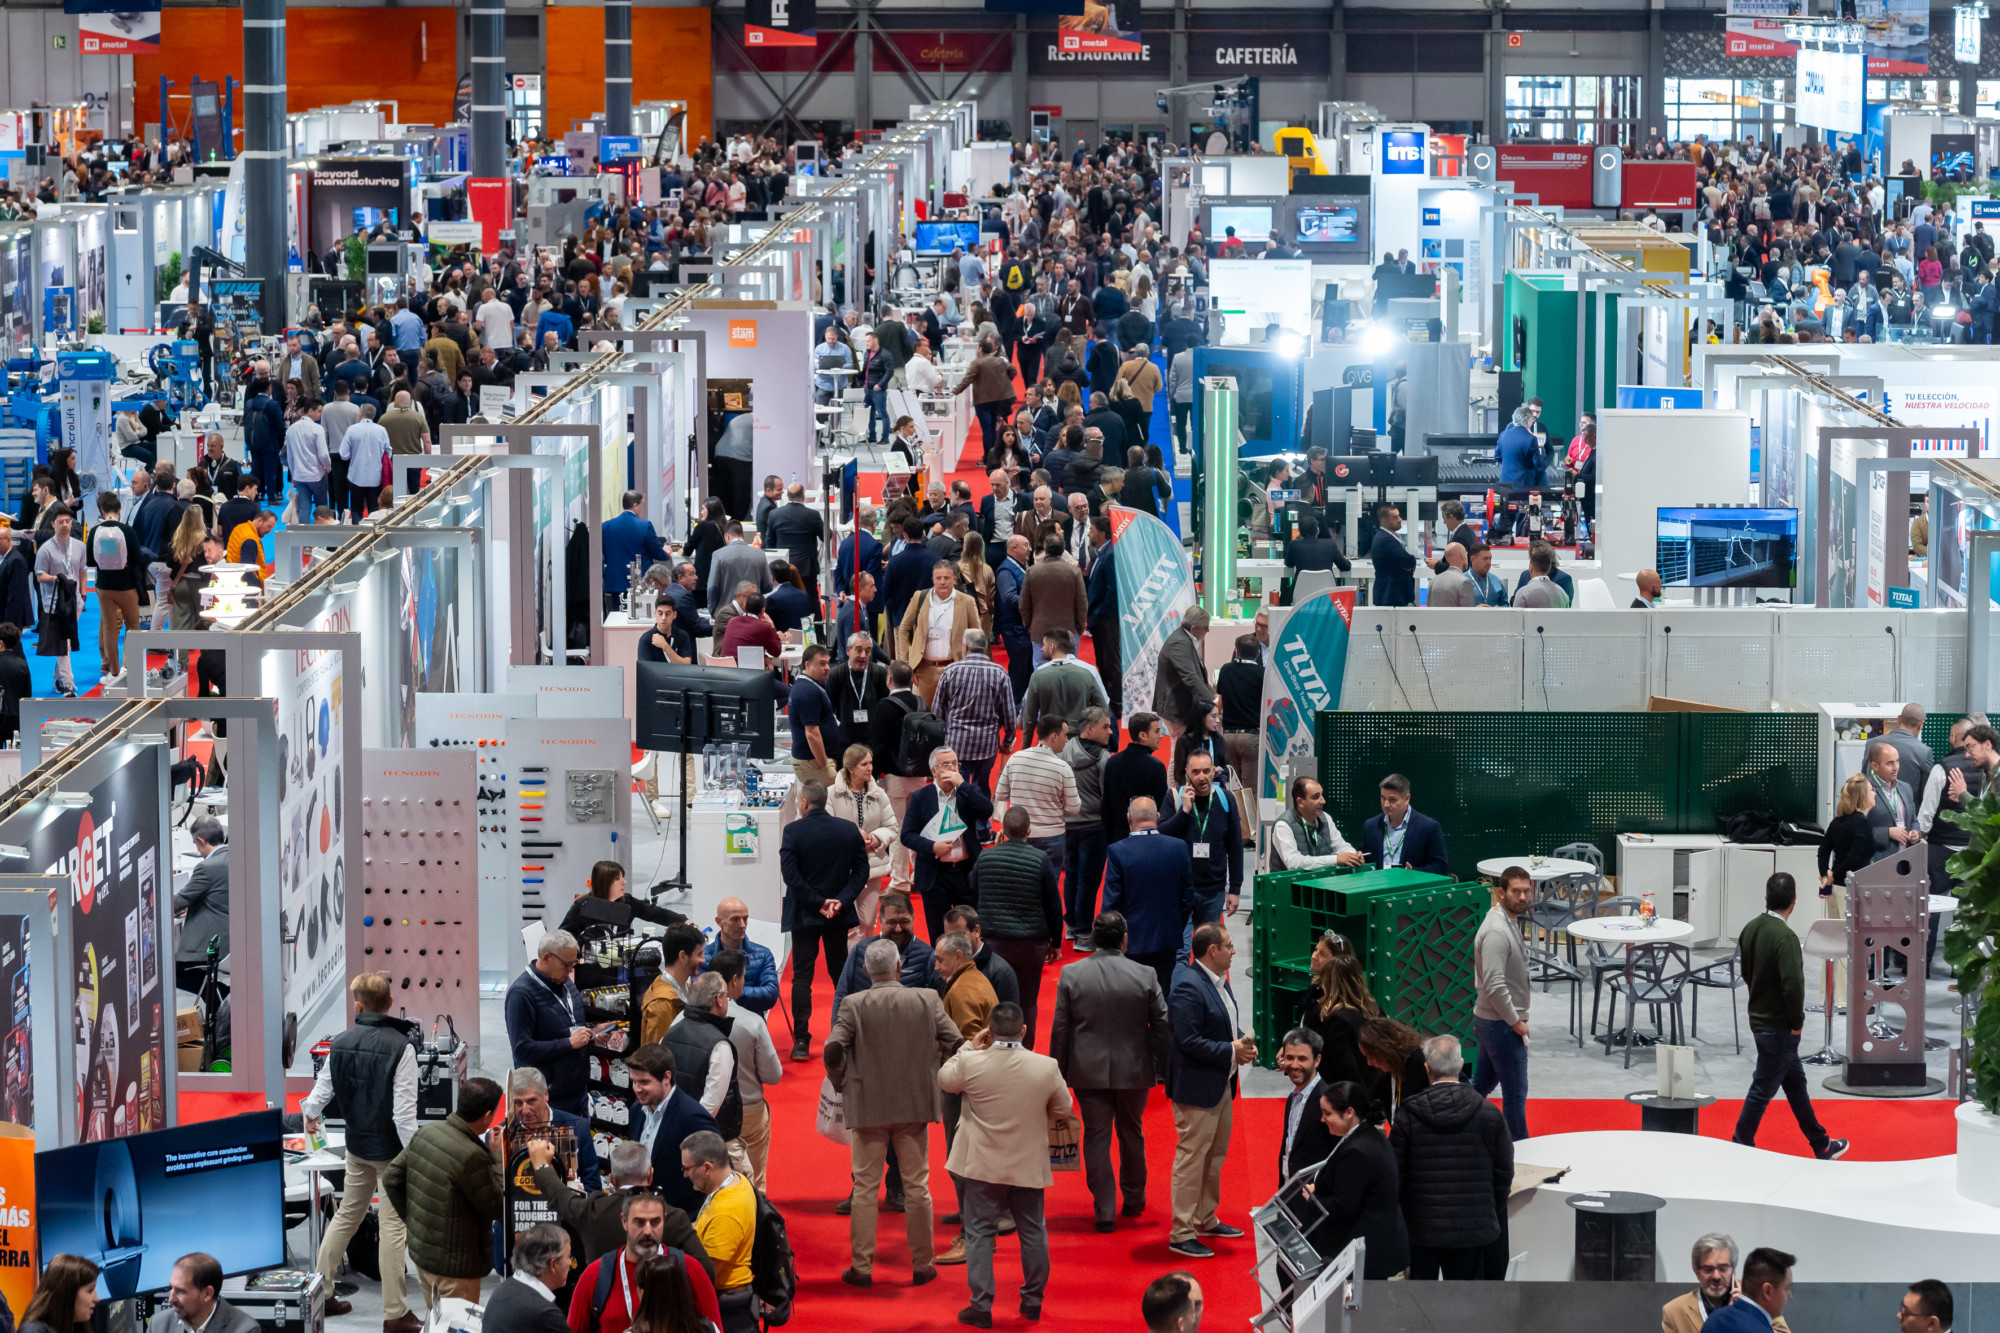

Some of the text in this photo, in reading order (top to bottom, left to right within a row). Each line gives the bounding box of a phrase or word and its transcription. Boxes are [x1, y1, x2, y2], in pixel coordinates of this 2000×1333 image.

[1082, 39, 1107, 47] metal
[1749, 42, 1774, 50] metal
[1216, 43, 1298, 64] CAFETERÍA
[313, 169, 359, 179] beyond
[313, 177, 399, 187] manufacturing
[214, 282, 260, 294] WIWA
[1917, 391, 1960, 402] ELECCIÓN,
[66, 407, 78, 454] yncroLift
[1892, 591, 1914, 603] TOTAL
[1333, 598, 1351, 624] TOTAL
[1283, 634, 1331, 712] TOTA
[45, 815, 113, 907] RGET
[165, 1154, 178, 1162] The
[219, 1146, 248, 1155] construction
[166, 1162, 186, 1172] avoids
[194, 1157, 223, 1168] unpleasant
[223, 1155, 242, 1165] grinding
[514, 1200, 548, 1211] FOR THE
[514, 1211, 558, 1222] TOUGHEST
